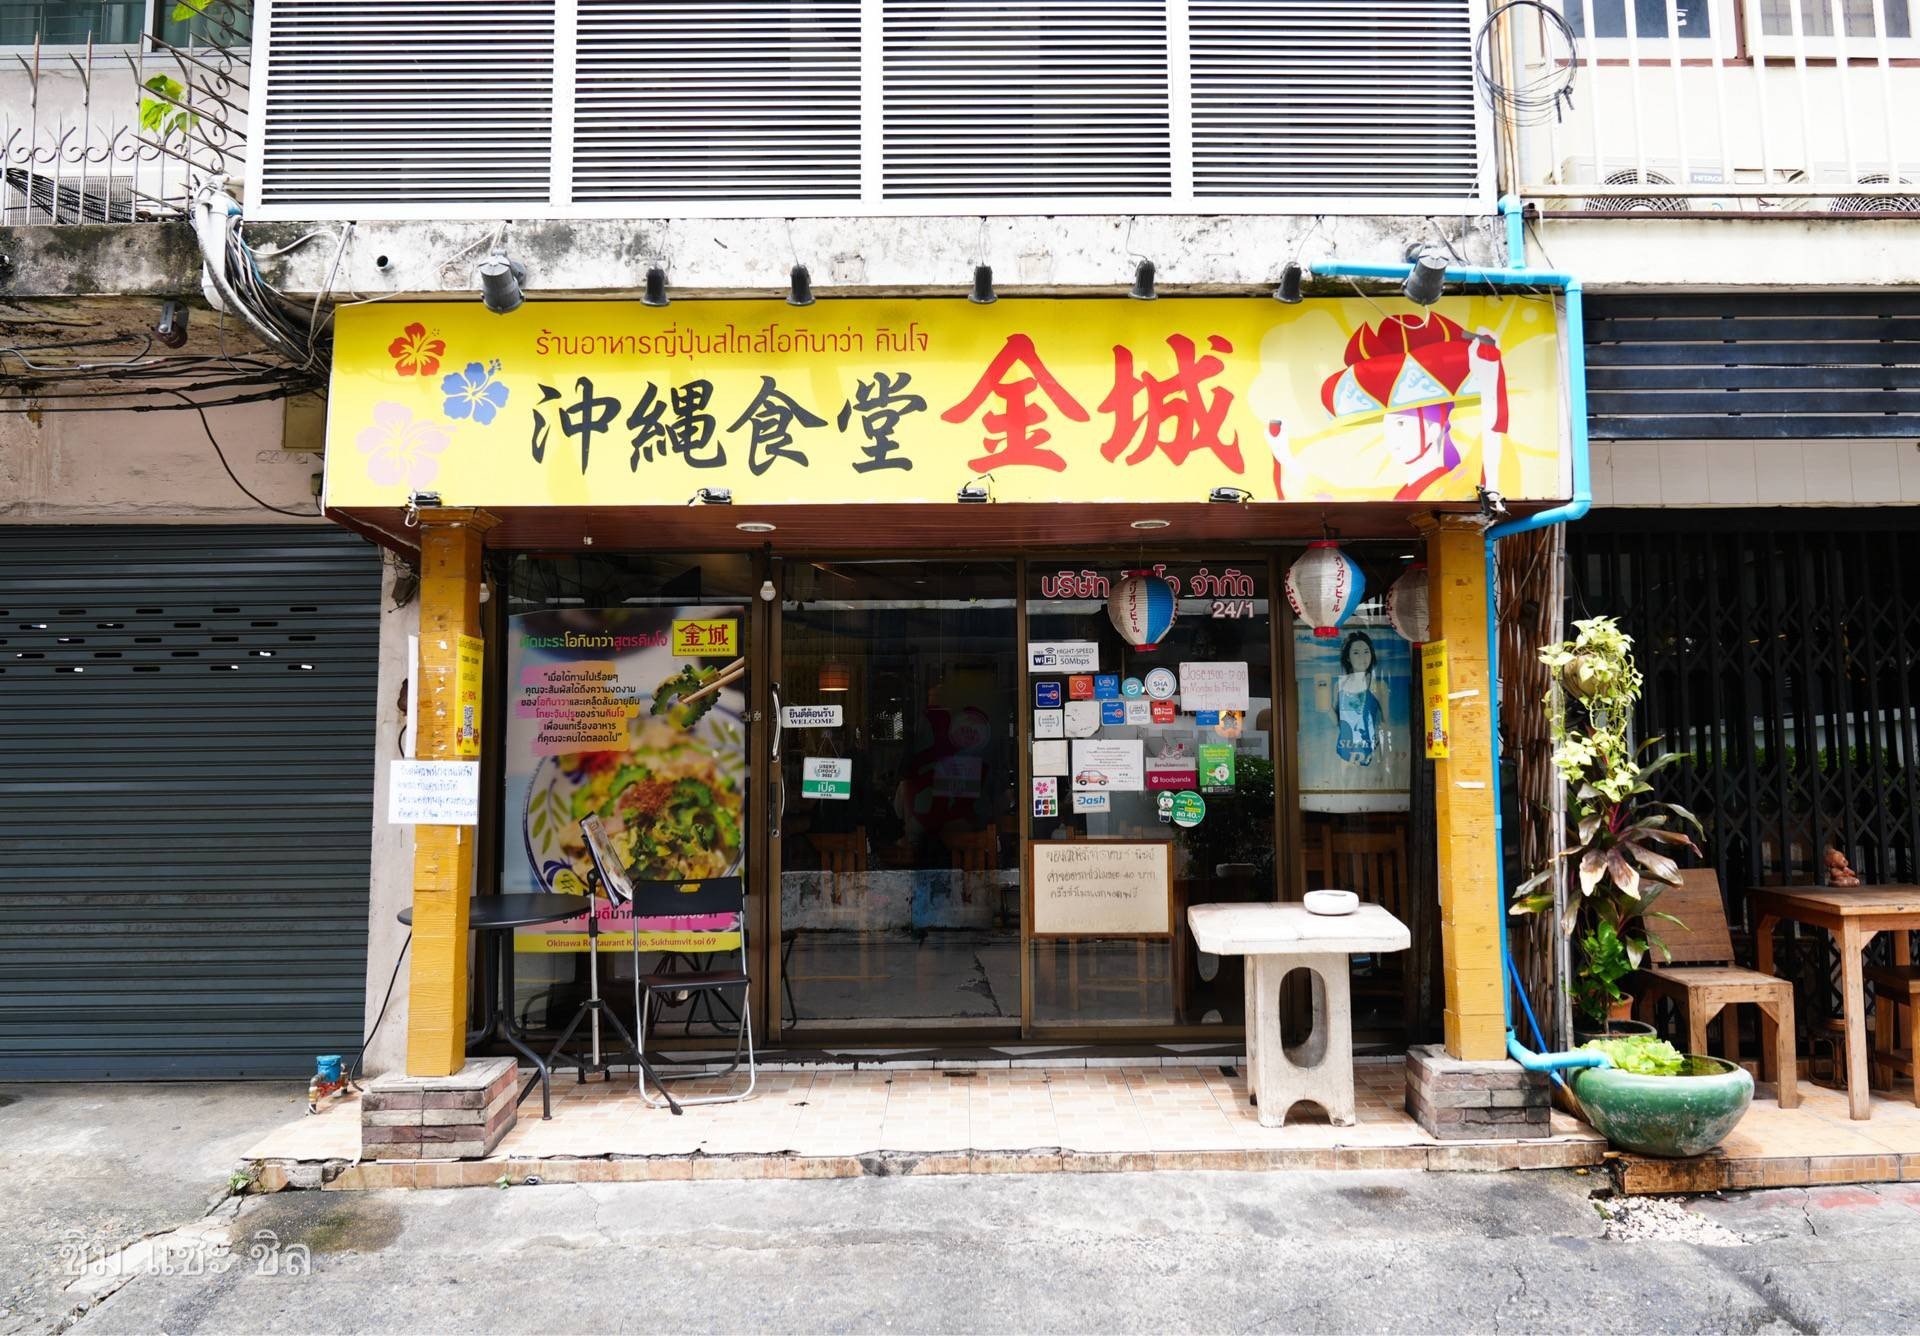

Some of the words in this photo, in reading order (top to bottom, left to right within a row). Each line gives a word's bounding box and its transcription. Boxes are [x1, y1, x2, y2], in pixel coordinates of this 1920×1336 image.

[535, 322, 863, 360] ร้านอาหารญี่ปุ่นสไตล์โอกินาว่า
[875, 322, 929, 353] คินโจ
[531, 372, 928, 476] 沖縄食堂
[941, 333, 1245, 475] 金城
[1041, 570, 1110, 598] บริษัท
[1190, 568, 1255, 597] จำกัด
[1211, 601, 1255, 619] 24/1
[678, 622, 729, 647] 金城
[1060, 658, 1090, 666] 50Mbps
[817, 782, 836, 793] เปิด
[1160, 775, 1191, 784] foodpanda
[546, 939, 581, 948] Okinawa
[583, 939, 625, 948] Retaurant
[651, 938, 692, 946] Sukhumvit
[706, 937, 717, 946] 69
